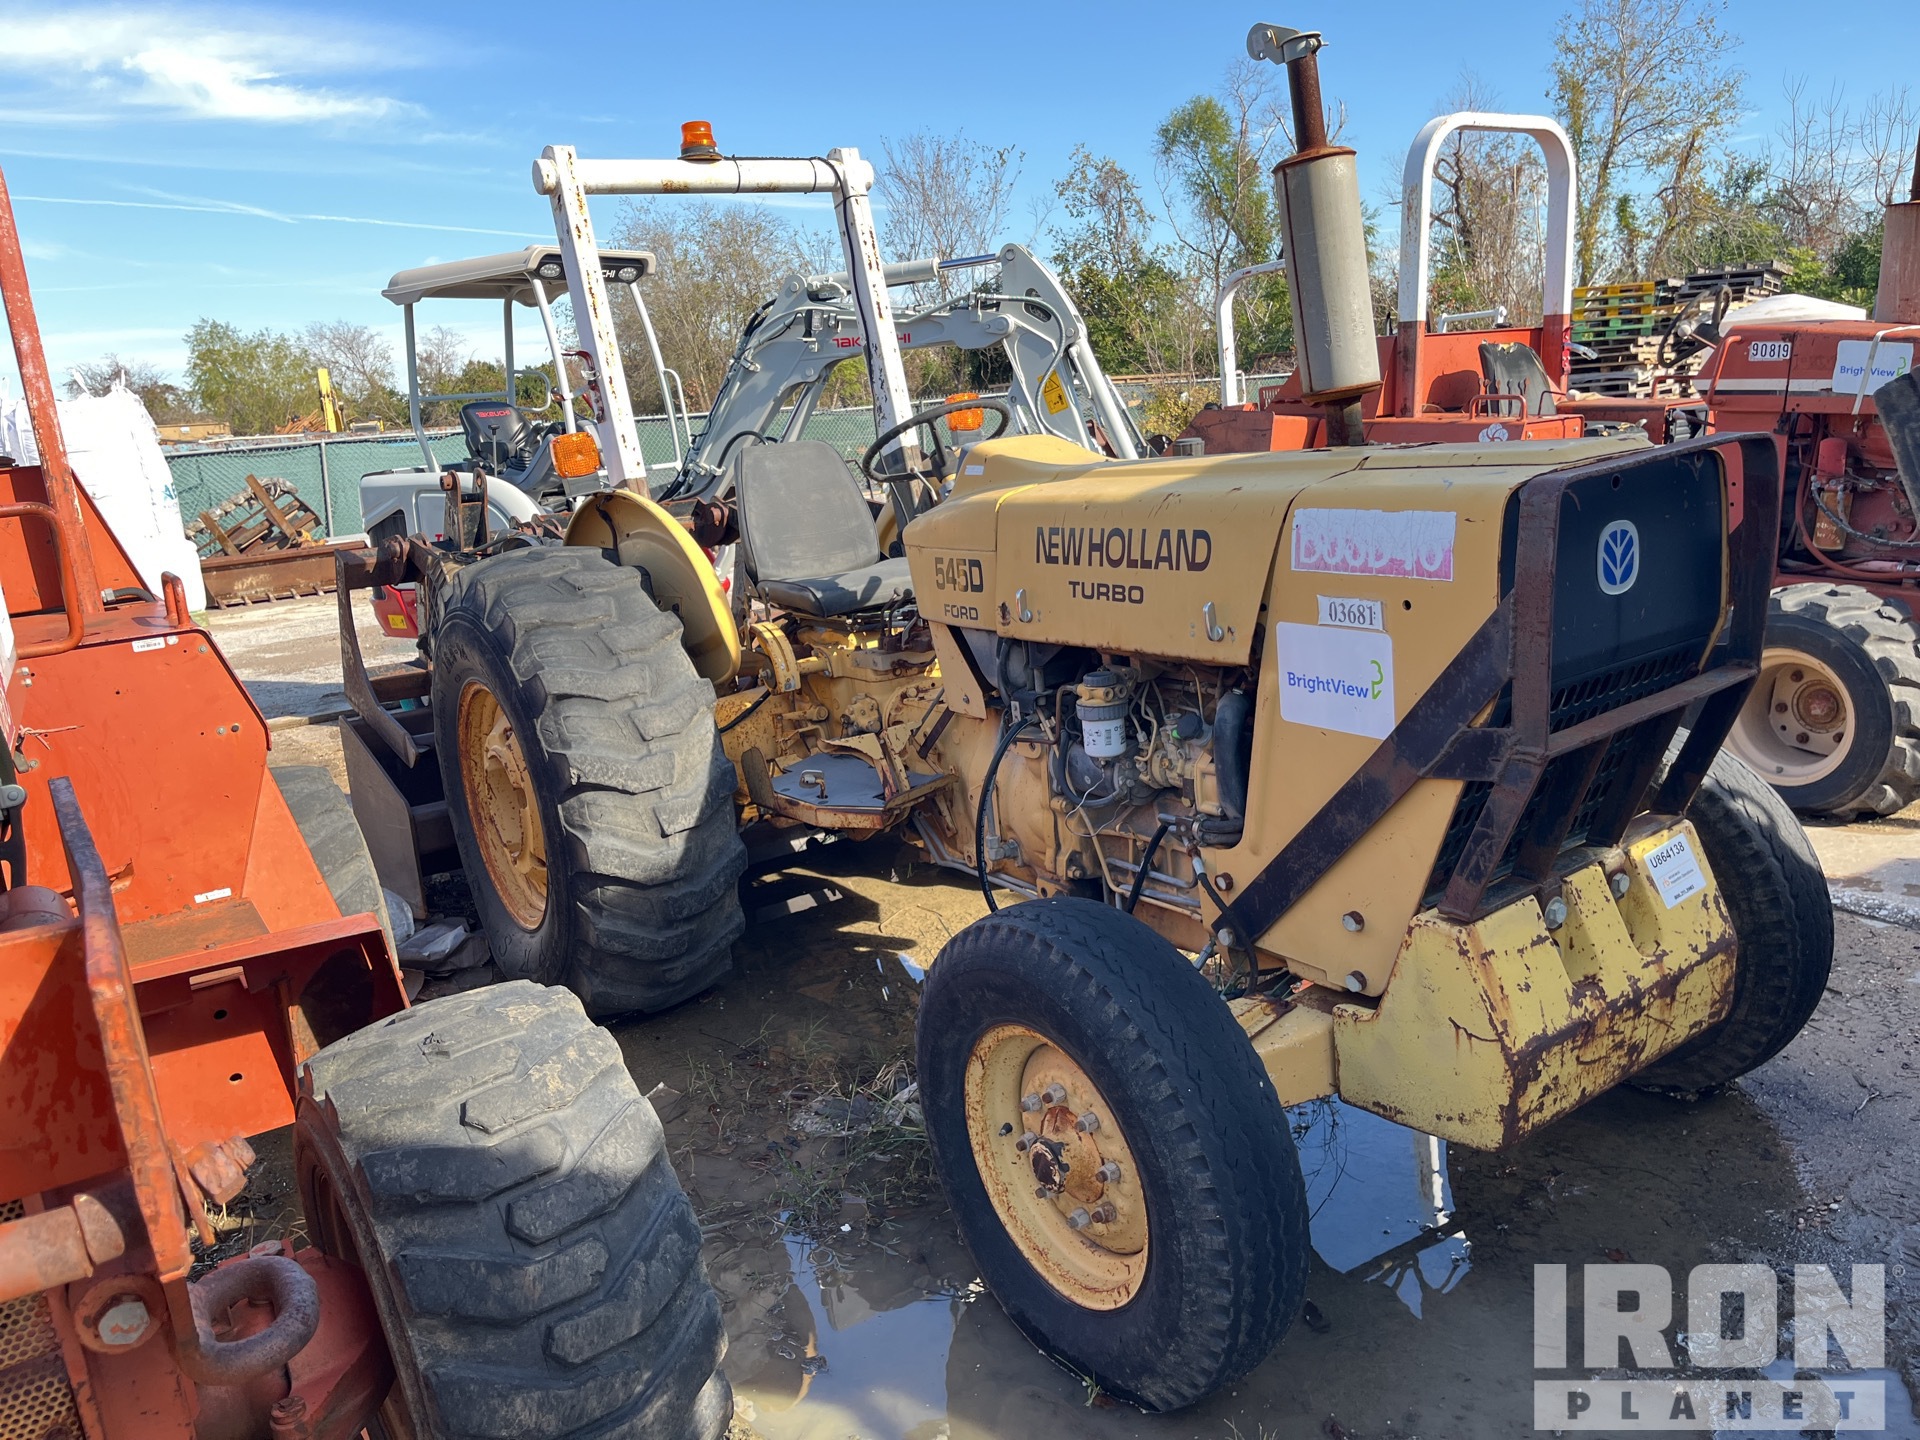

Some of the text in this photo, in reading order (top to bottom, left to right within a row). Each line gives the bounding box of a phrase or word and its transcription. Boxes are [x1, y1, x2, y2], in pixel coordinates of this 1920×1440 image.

[1752, 343, 1789, 358] 90819
[1840, 366, 1895, 376] BrighView
[1088, 527, 1212, 572] HOLLAND
[935, 557, 984, 593] 545D
[1068, 581, 1144, 604] TURBO
[944, 604, 979, 620] FORD
[1329, 601, 1374, 625] 03681
[1287, 672, 1369, 698] BrightView
[1650, 841, 1685, 868] U864138
